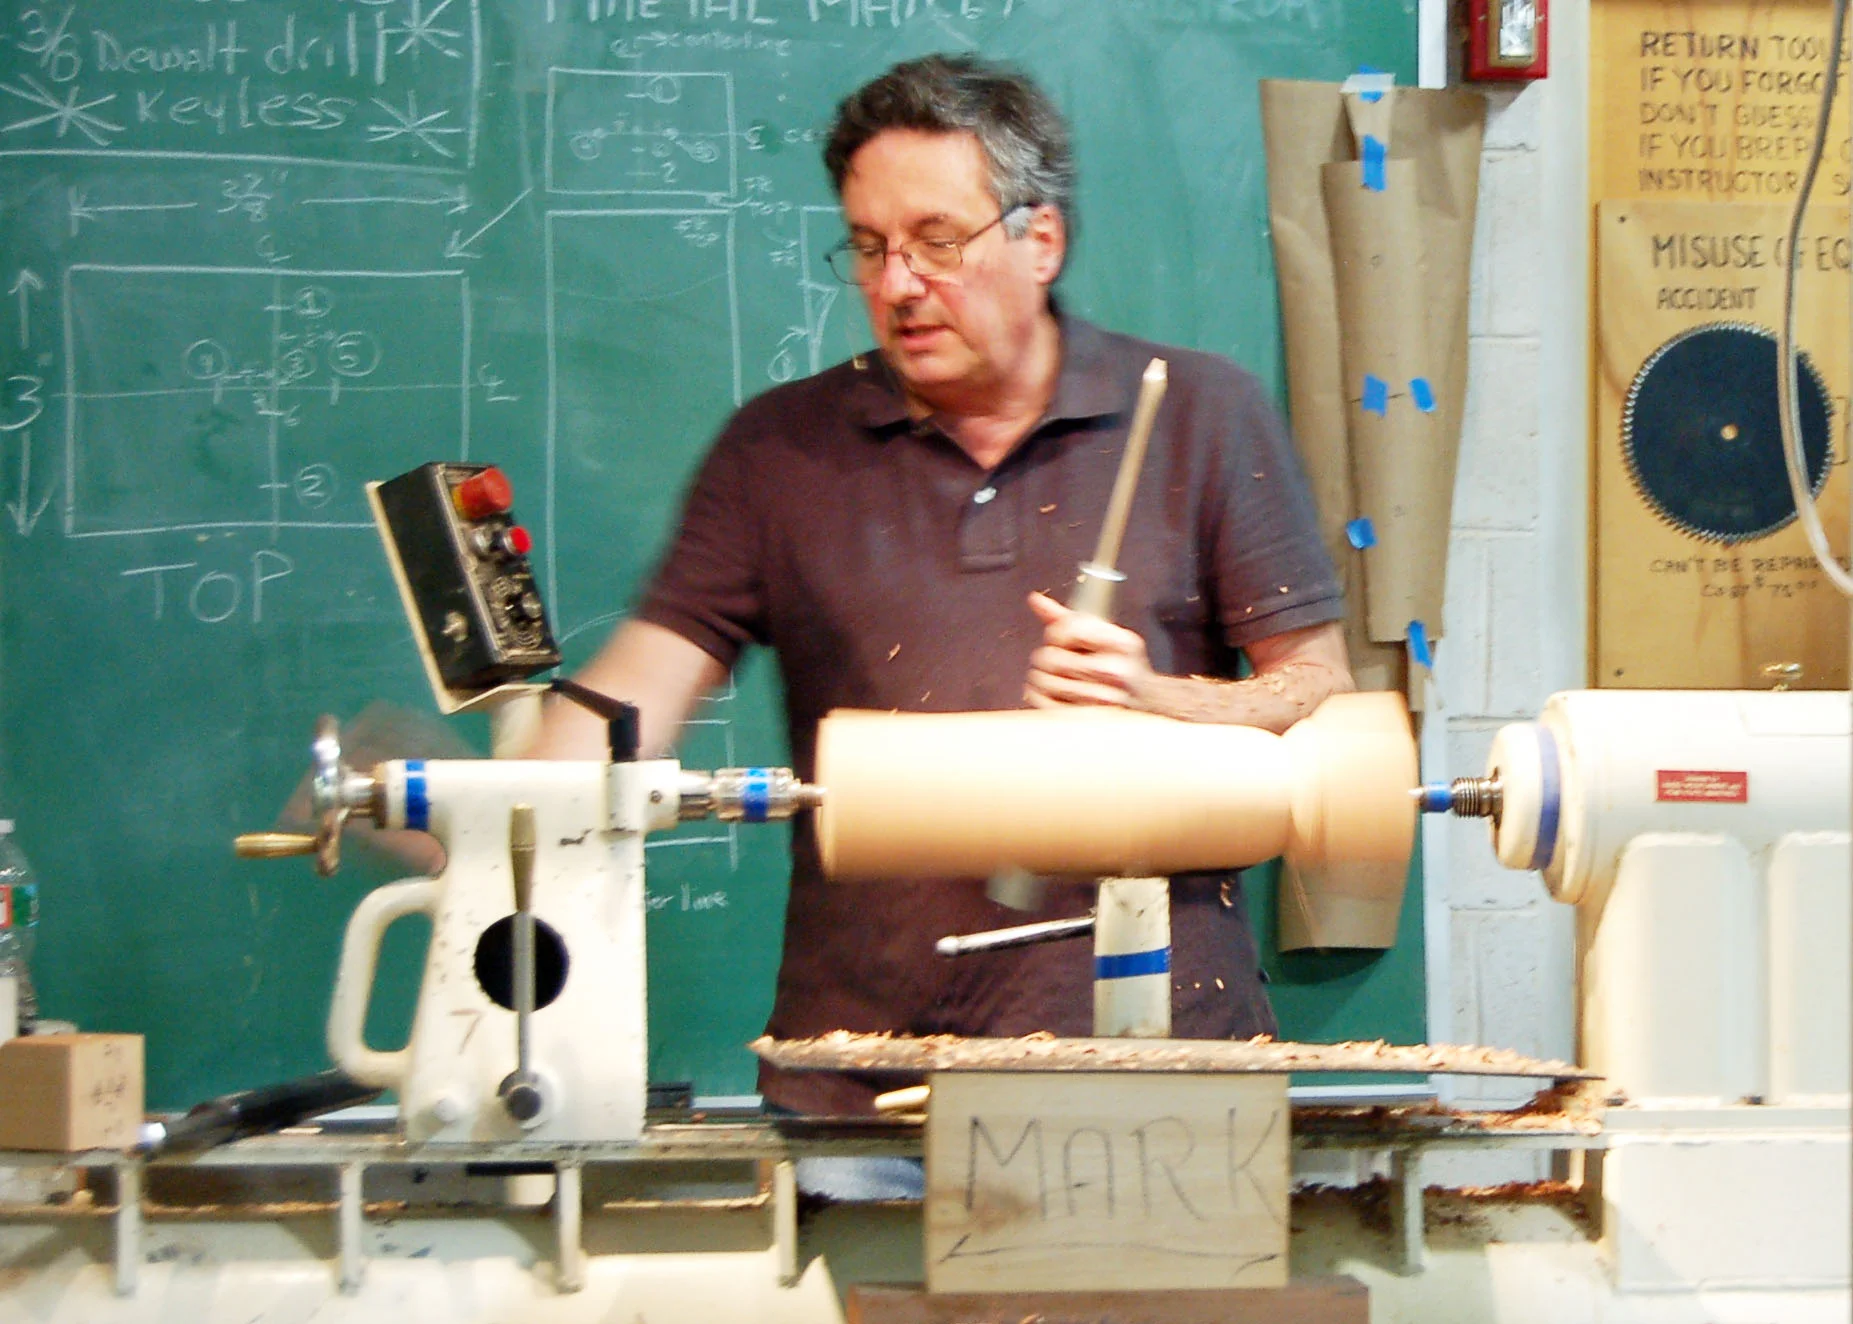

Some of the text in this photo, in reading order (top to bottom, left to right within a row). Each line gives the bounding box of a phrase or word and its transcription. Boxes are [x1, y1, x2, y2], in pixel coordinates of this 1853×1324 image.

[1640, 31, 1759, 60] RETURN
[1641, 66, 1663, 93] IF
[1671, 66, 1731, 94] YOU
[1640, 133, 1662, 158] IF
[1671, 133, 1727, 159] YOU
[1639, 169, 1798, 194] INSTRUCTOR
[1651, 233, 1766, 269] MISUSE
[1657, 286, 1759, 310] ACCIDENT
[121, 550, 293, 622] TOP
[448, 1008, 485, 1056] 7
[964, 1106, 1285, 1226] MARK
